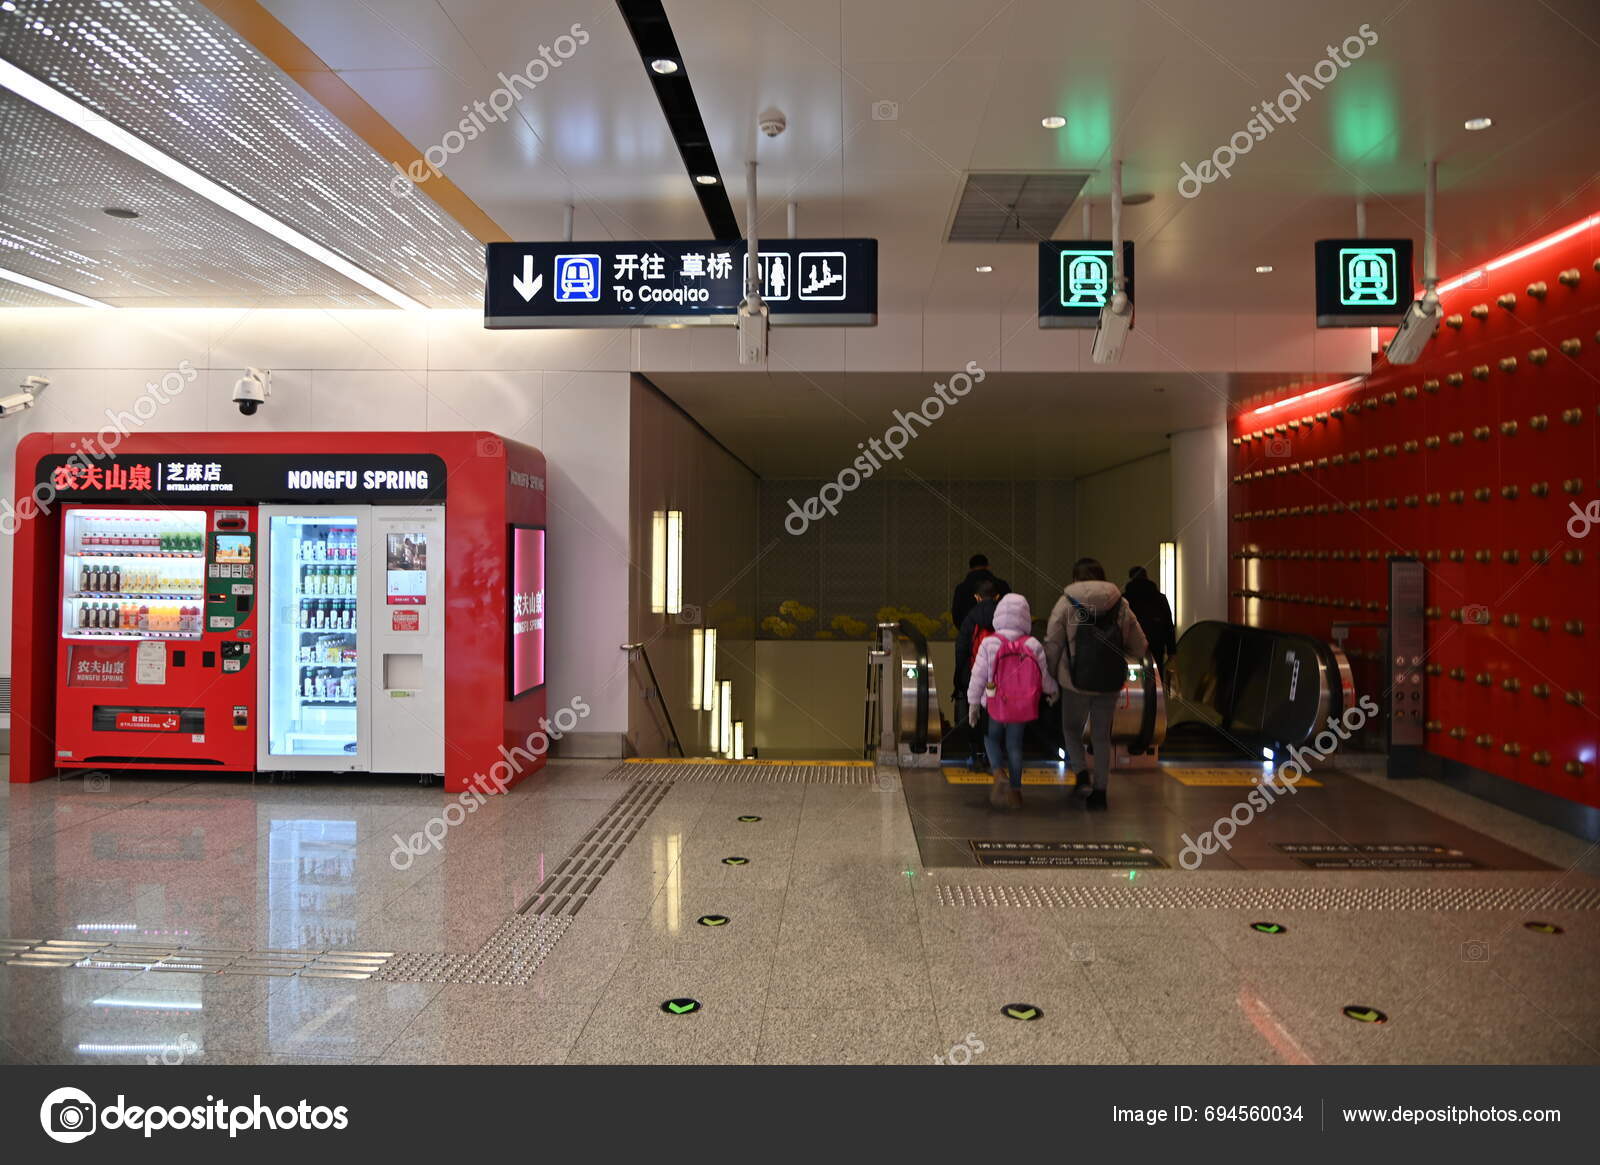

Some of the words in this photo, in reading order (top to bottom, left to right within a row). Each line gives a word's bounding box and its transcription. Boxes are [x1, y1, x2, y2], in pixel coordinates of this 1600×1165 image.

[613, 253, 666, 281] 开往
[679, 252, 733, 280] 草桥
[612, 285, 634, 302] To
[638, 285, 710, 305] Caoqiao
[53, 463, 152, 491] 农夫山泉
[166, 462, 222, 481] 芝麻店
[287, 470, 357, 490] NONGFU
[363, 470, 429, 490] SPRING
[166, 483, 209, 491] INTELLIGENT
[210, 483, 233, 491] STORE
[77, 660, 125, 674] 农夫山泉
